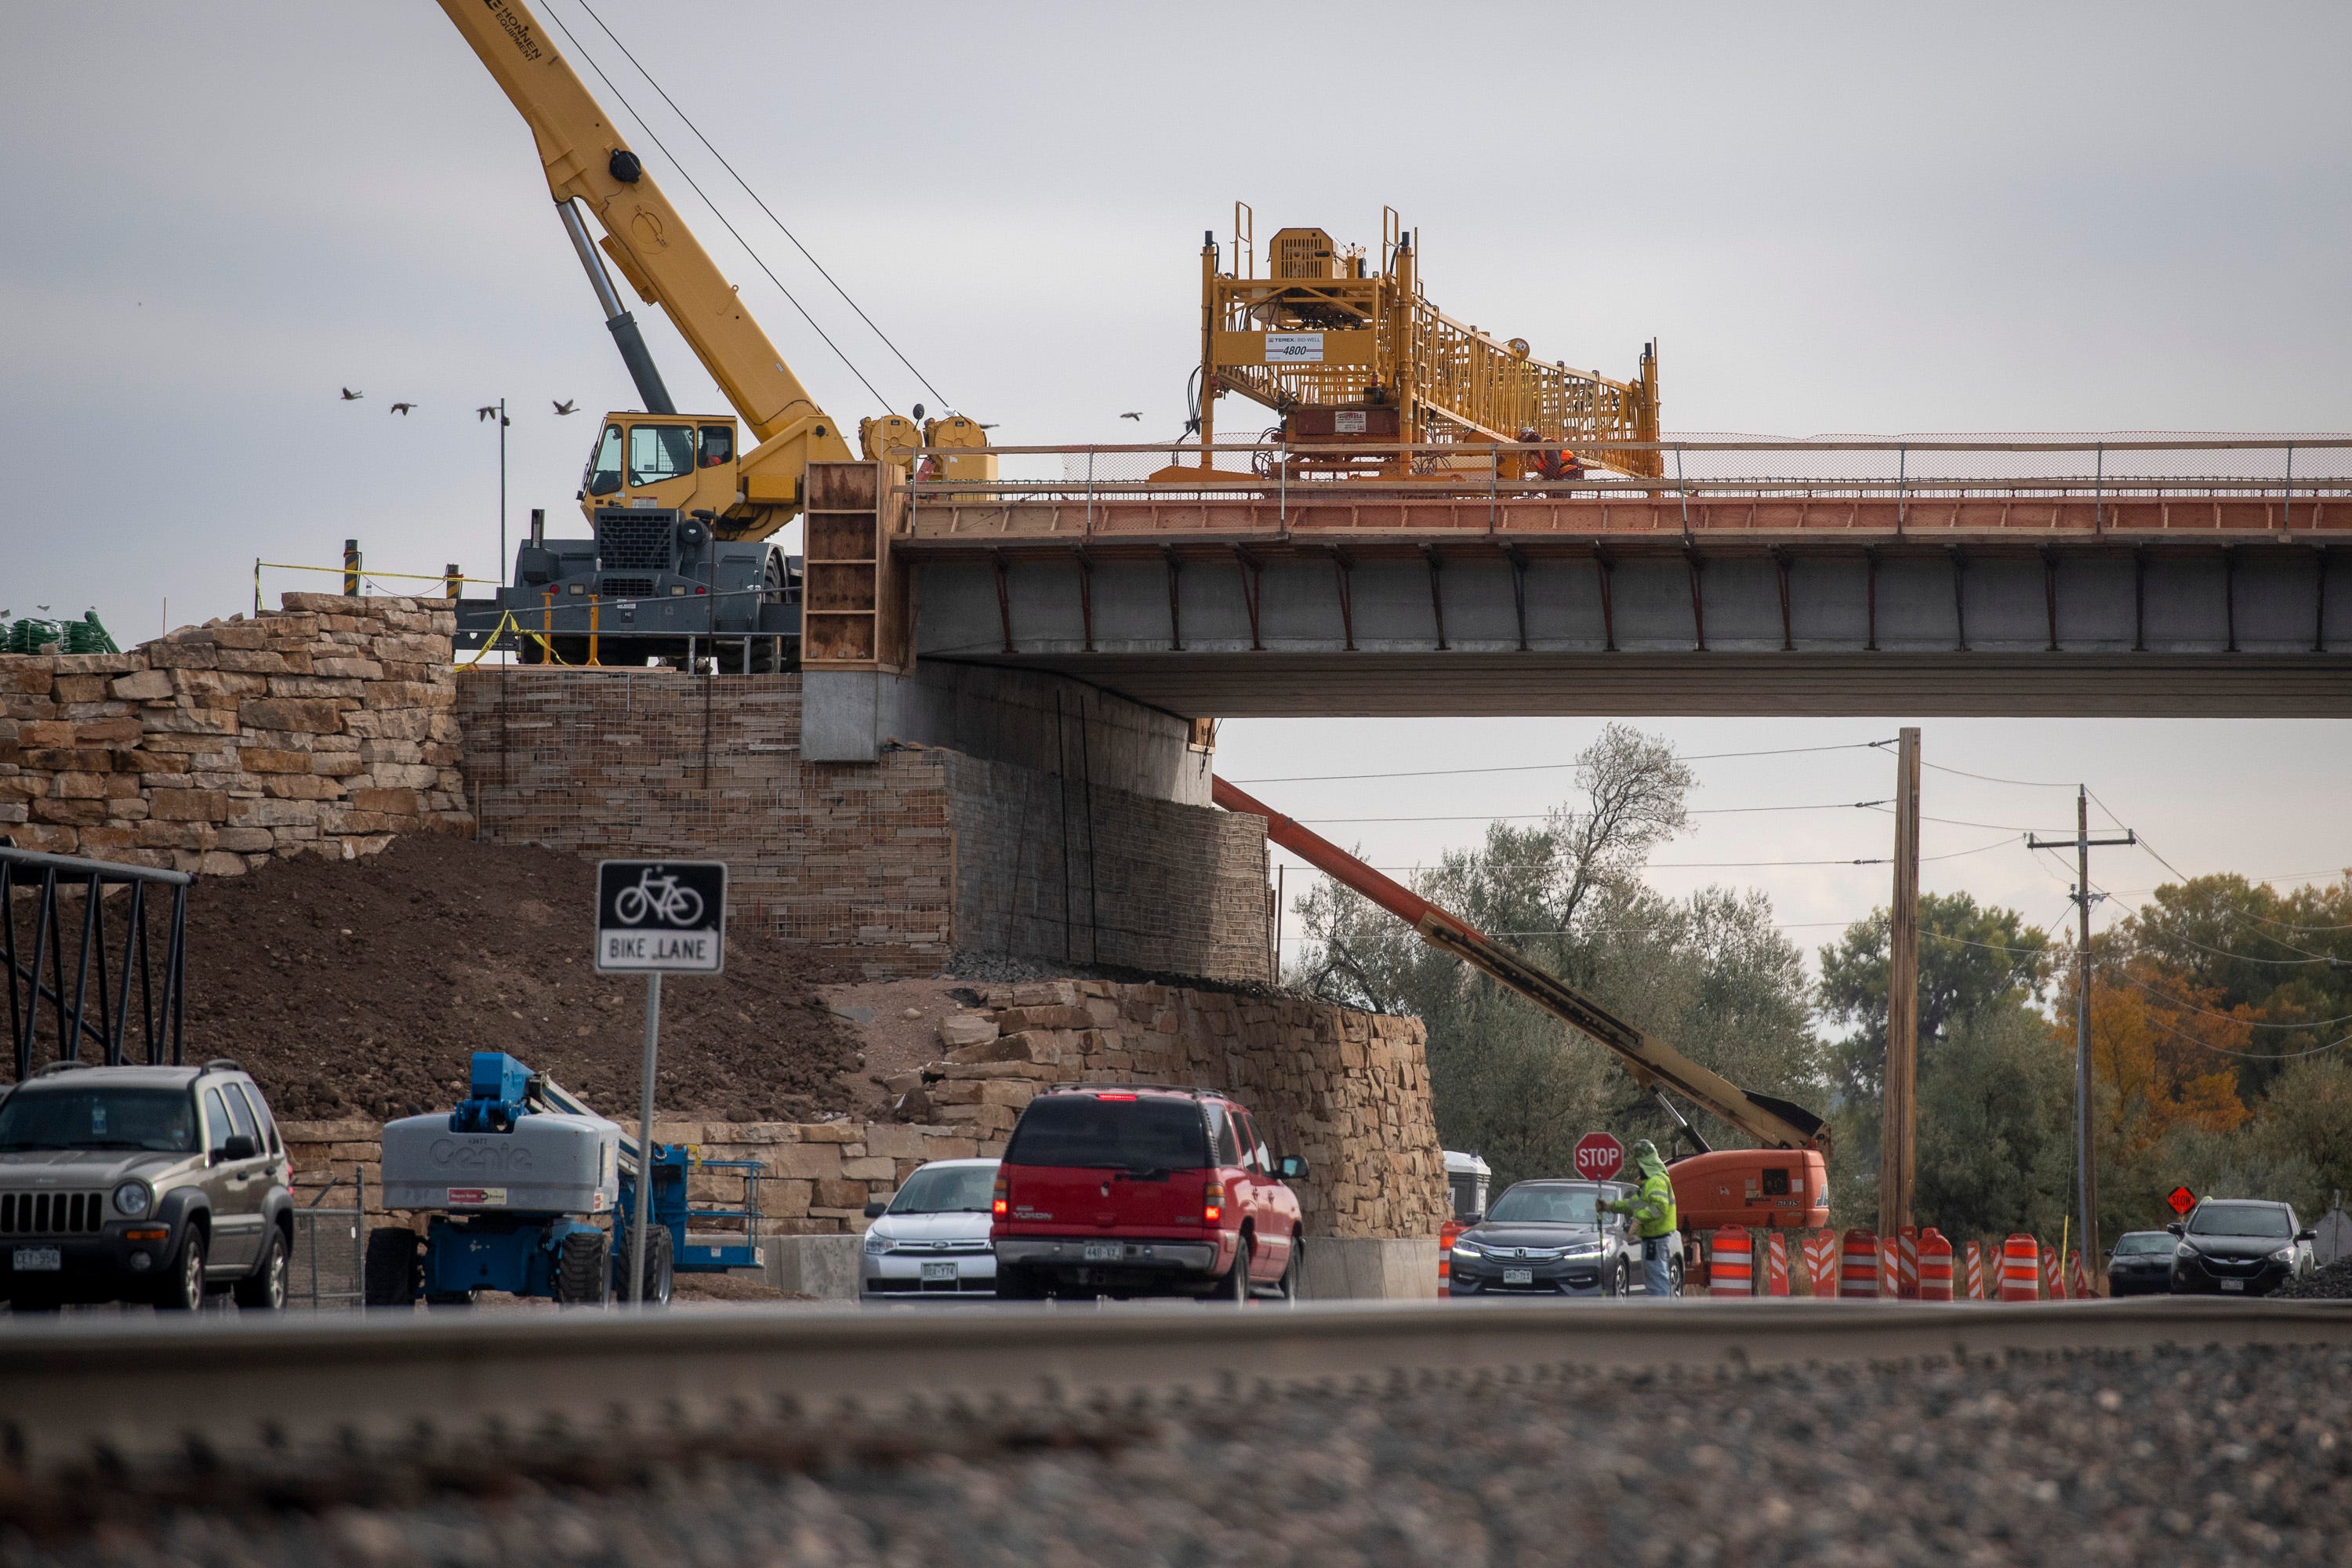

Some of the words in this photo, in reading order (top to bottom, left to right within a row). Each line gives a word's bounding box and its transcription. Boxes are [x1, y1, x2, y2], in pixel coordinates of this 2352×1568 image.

[495, 13, 535, 62] EQUIPMENT
[502, 7, 543, 59] HONNEN
[1283, 346, 1307, 355] 4800
[609, 938, 646, 958] BIKE
[658, 938, 706, 960] LANE
[430, 1138, 533, 1171] Genie
[1579, 1147, 1619, 1167] STOP
[2172, 1194, 2190, 1206] SLOW
